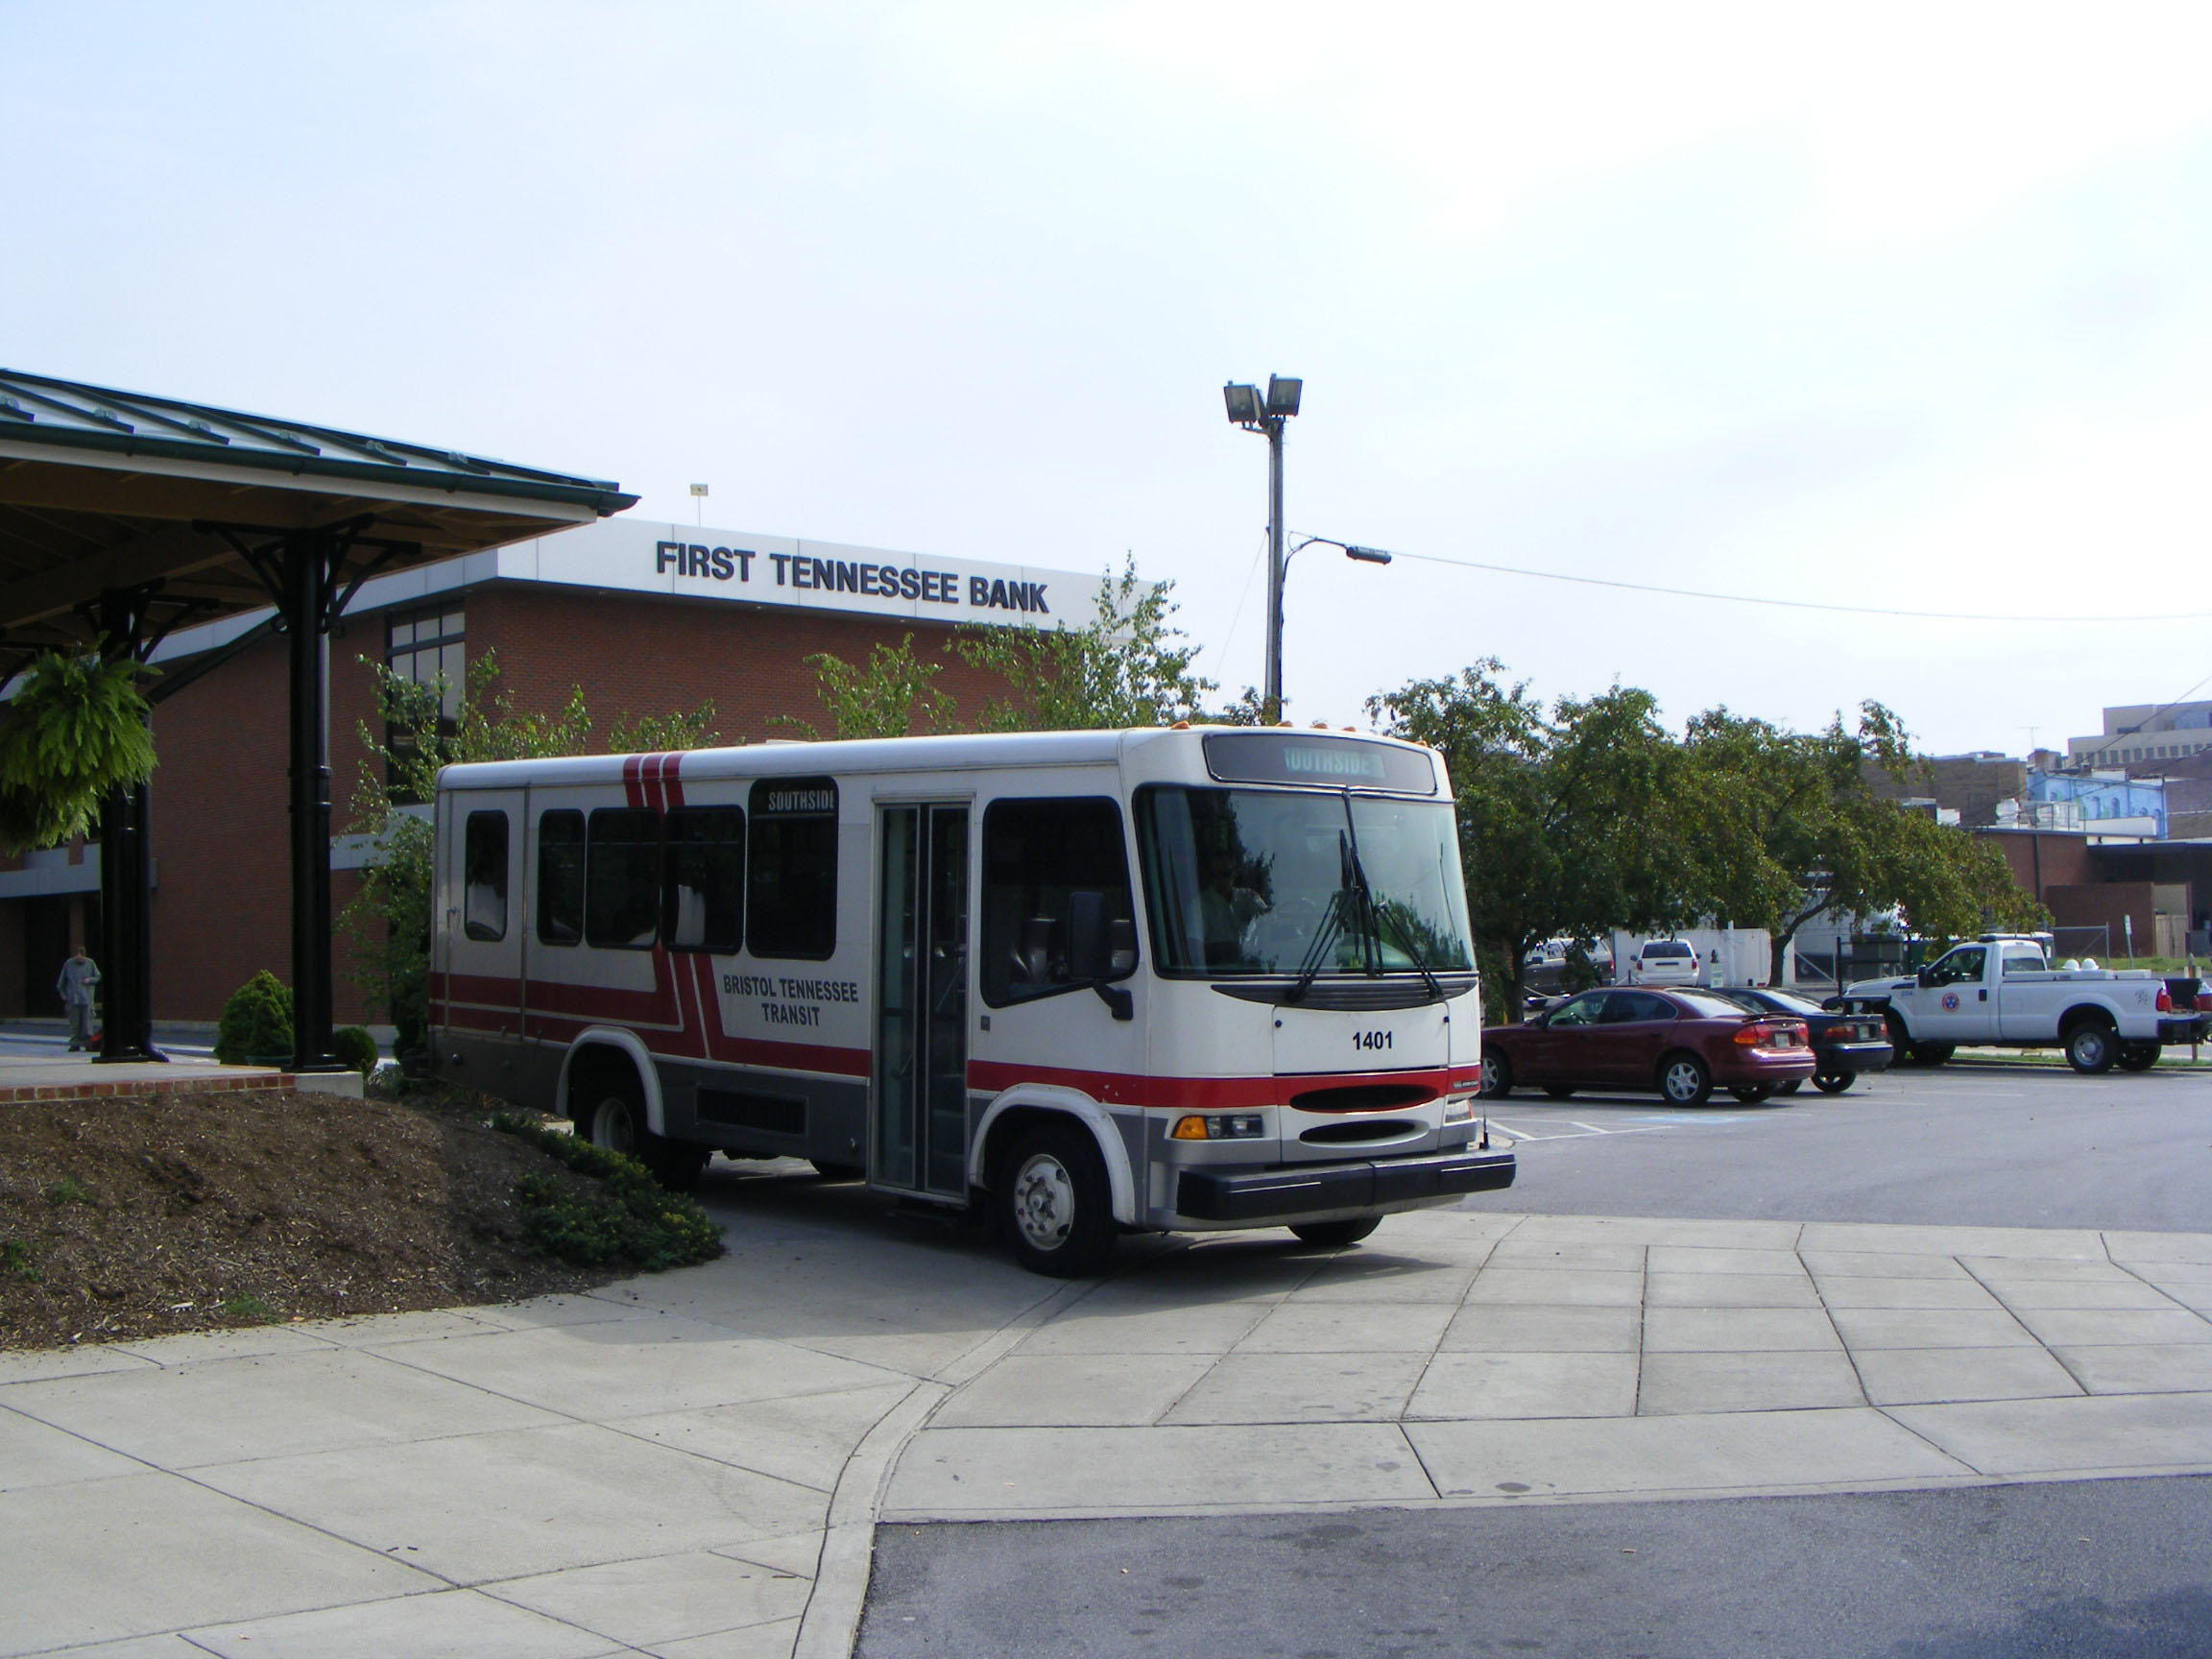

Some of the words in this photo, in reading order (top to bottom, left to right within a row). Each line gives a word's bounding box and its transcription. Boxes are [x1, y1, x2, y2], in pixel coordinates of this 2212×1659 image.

[657, 541, 756, 583] FIRST
[769, 553, 959, 605] TENNESSEE
[970, 576, 1050, 614] BANK
[723, 974, 777, 997] BRISTOL
[780, 978, 859, 1002] TENNESSEE
[761, 1003, 820, 1026] TRANSIT
[1353, 1031, 1392, 1050] 1401
